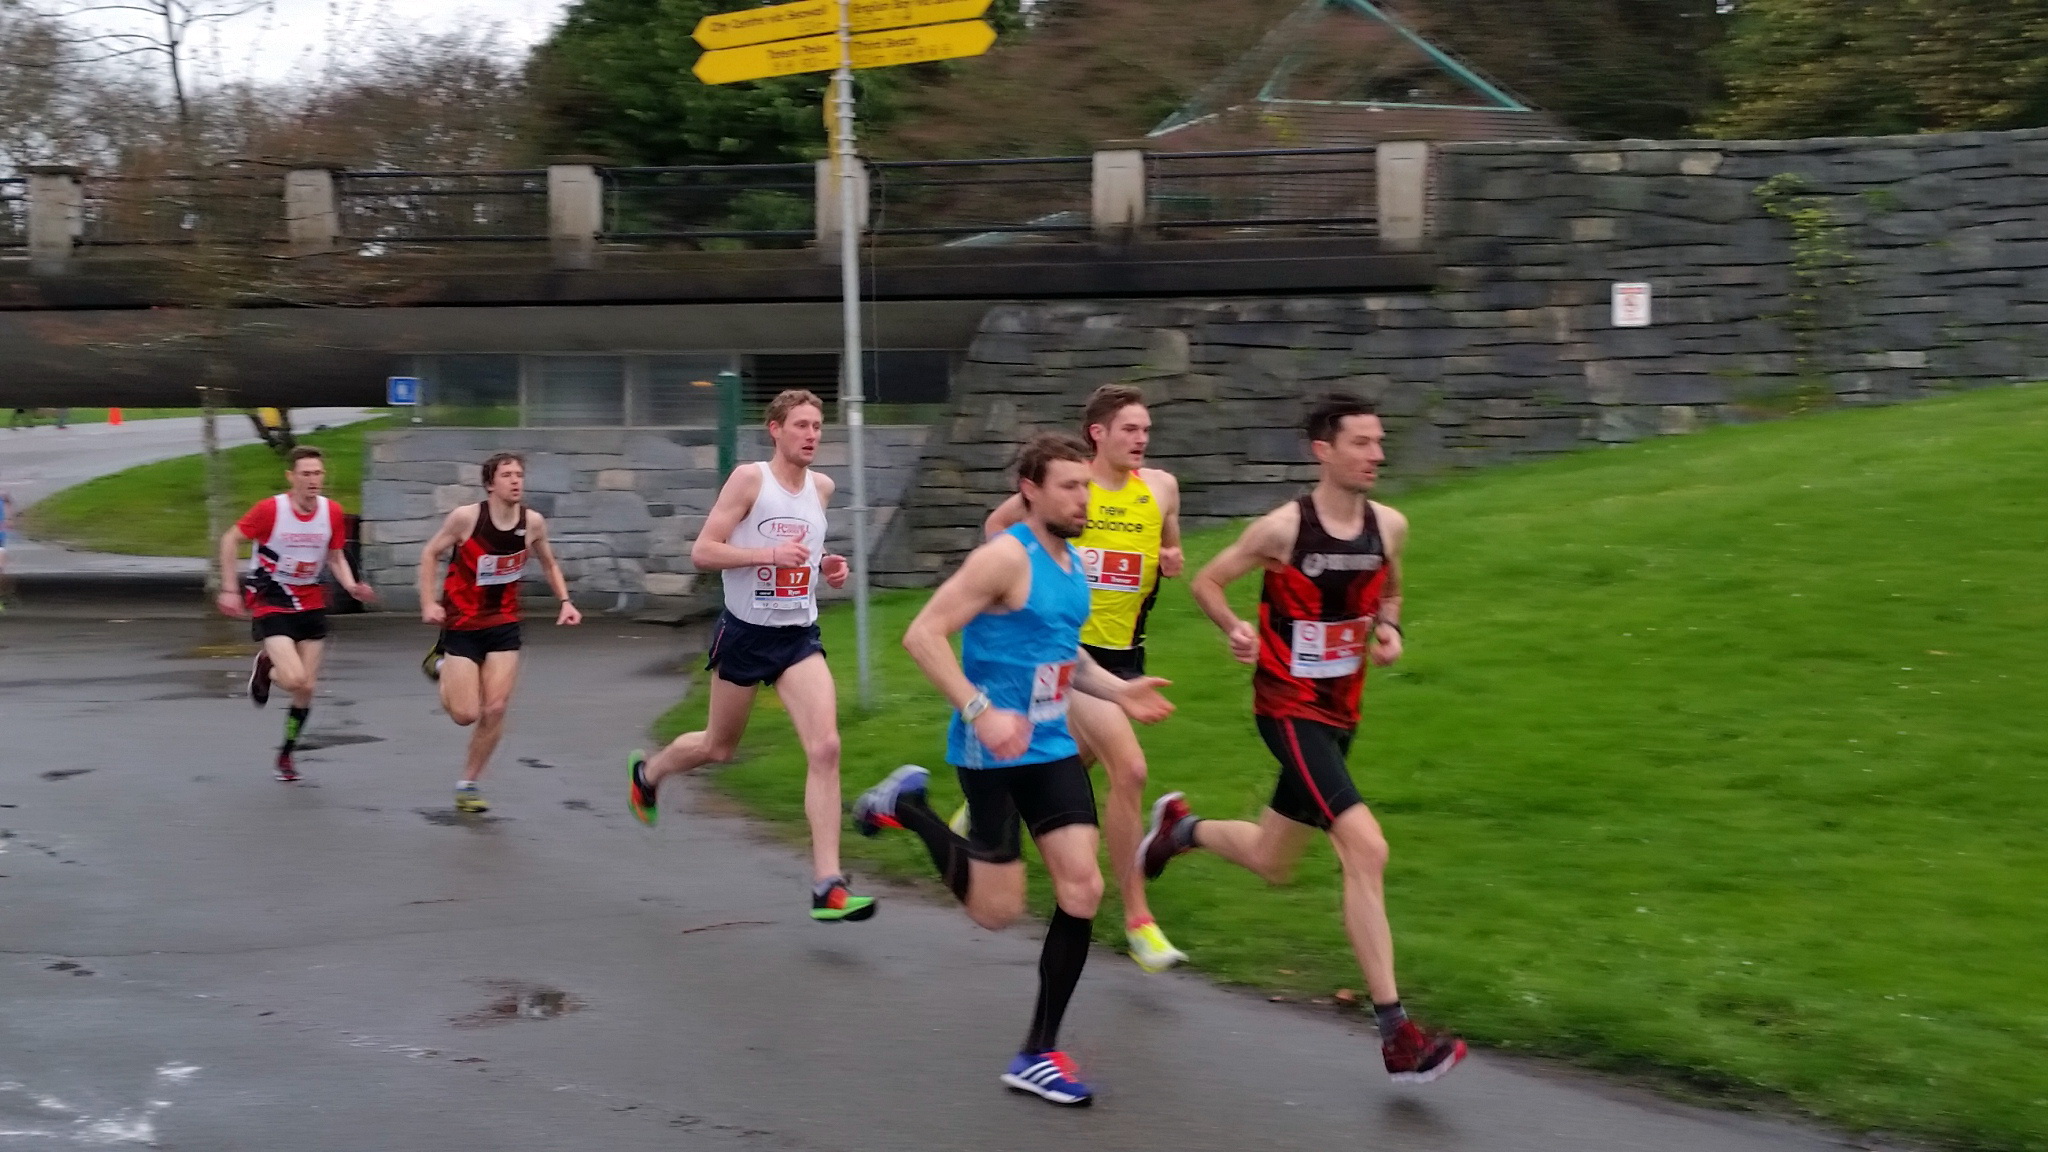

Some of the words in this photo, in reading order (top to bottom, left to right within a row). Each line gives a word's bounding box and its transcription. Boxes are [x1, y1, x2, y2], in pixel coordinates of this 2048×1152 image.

[710, 22, 727, 33] City
[884, 36, 918, 48] Beach
[1098, 505, 1127, 516] new
[1085, 518, 1143, 533] balance
[1118, 558, 1129, 572] 3
[789, 572, 804, 584] 17
